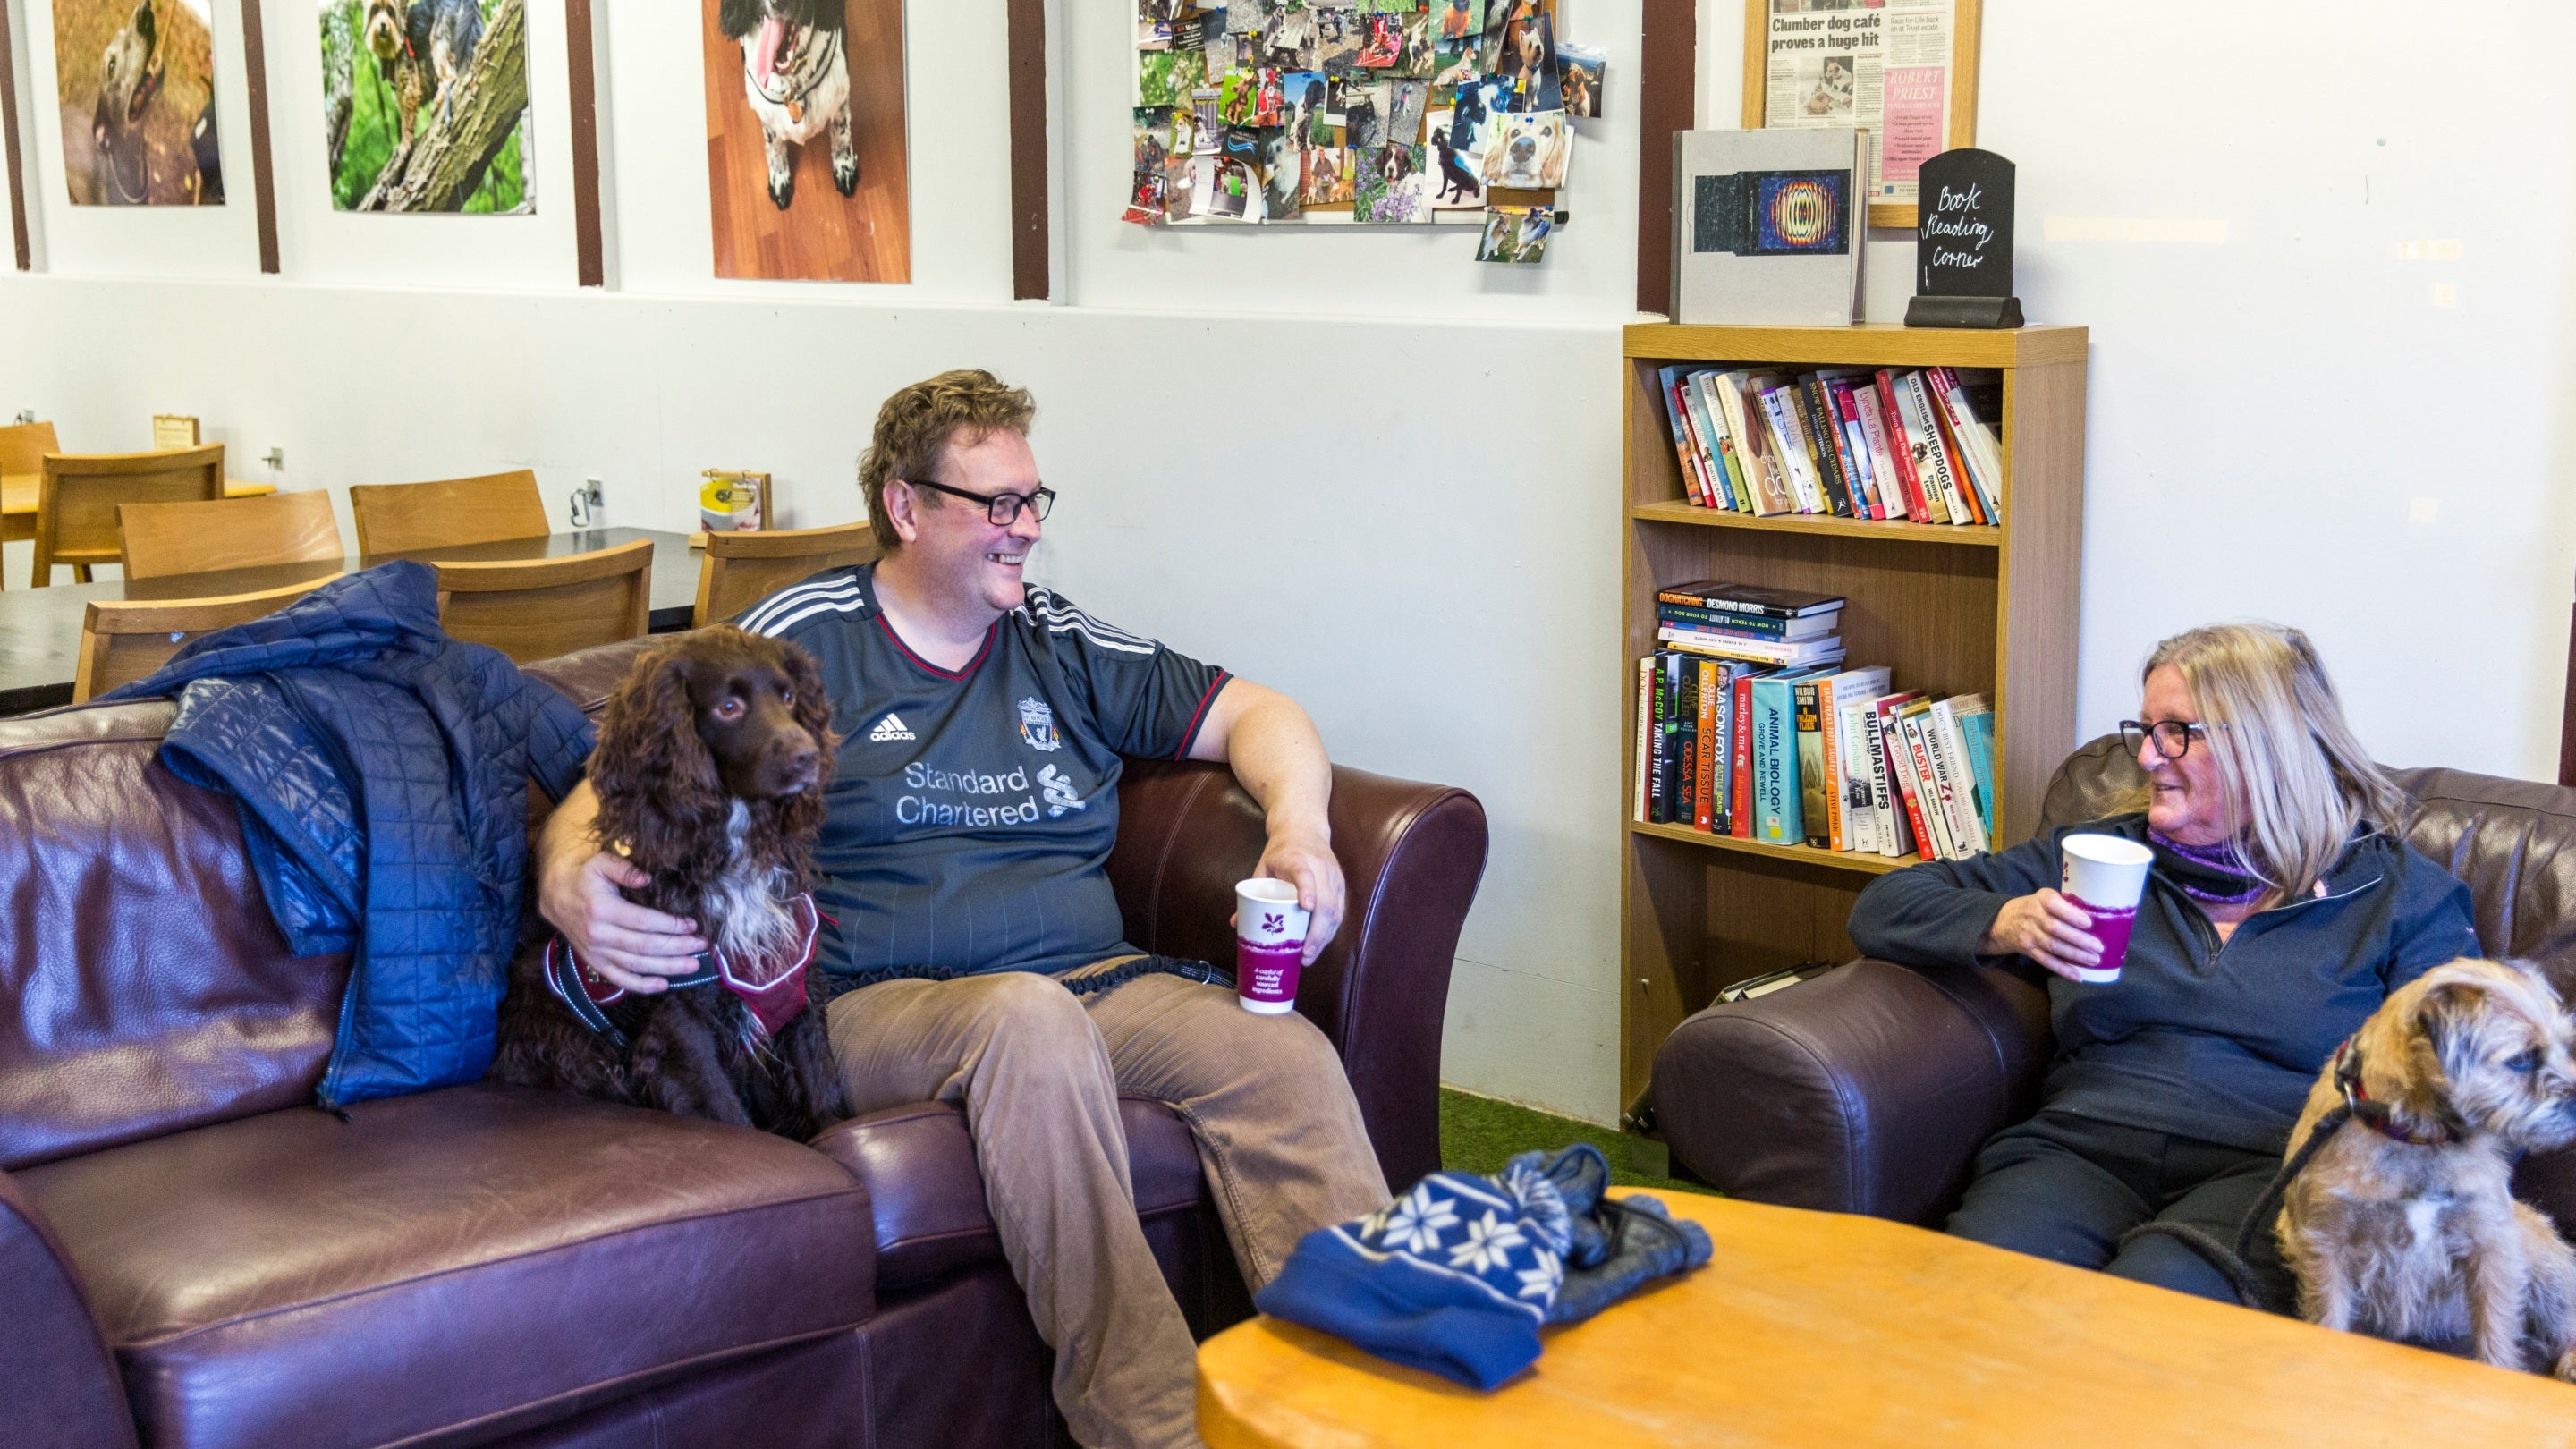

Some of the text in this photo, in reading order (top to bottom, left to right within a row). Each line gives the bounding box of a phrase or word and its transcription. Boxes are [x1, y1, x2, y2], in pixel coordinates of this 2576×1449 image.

[1772, 13, 1881, 33] Clumber dog café
[1771, 32, 1879, 53] proves a huge hit
[1890, 71, 1940, 84] ROBERT
[1893, 87, 1936, 100] PRIEST
[1938, 182, 1982, 212] Book
[1926, 213, 1994, 251] Reading
[1933, 246, 1983, 267] Corner
[1704, 377, 1716, 404] Friends
[1716, 417, 1724, 434] Life
[1784, 408, 1802, 446] ENDAL
[1809, 382, 1842, 485] SNOW FALLING ON CEDARS
[1811, 414, 1827, 458] DAVID GUTERSON
[1860, 392, 1885, 457] Lynda La Plante
[1911, 377, 1919, 393] OLD
[1916, 394, 1930, 424] ENGLISH
[1924, 424, 1953, 490] SHEEPDOGS
[1891, 410, 1916, 482] Train Your Dog Positively
[1707, 463, 1724, 504] DAVID GRANT
[1923, 479, 1935, 501] Lewis
[1928, 475, 1941, 502] Damien
[1659, 592, 1703, 607] DOGWATCHING
[1707, 598, 1764, 614] DESMOND MORRIS
[1709, 614, 1730, 624] RELATIVITY
[1640, 670, 1648, 697] DOG
[1682, 675, 1690, 716] CUSSLER
[1689, 684, 1699, 709] CLIVE
[1700, 670, 1709, 719] OLLERTON
[1794, 687, 1815, 696] WILBUR
[1824, 686, 1832, 704] EASY
[1796, 696, 1813, 705] SMITH
[1715, 687, 1726, 763] JASON FOX
[1796, 714, 1818, 722] FALCON
[1799, 722, 1815, 731] FLIES
[1826, 706, 1834, 727] PEASY
[870, 731, 916, 741] adidas
[1652, 668, 1665, 798] A.P. McCOY TAKING THE FALL
[1739, 735, 1746, 750] me
[1826, 728, 1835, 747] PUPPY
[1847, 711, 1863, 775] John Grisham
[1891, 736, 1899, 745] A
[1699, 728, 1711, 803] SCAR TISSUE
[1758, 723, 1767, 802] GROVE AND NEWELL
[1767, 708, 1783, 815] ANIMAL BIOLOGY
[1866, 710, 1889, 810] BULLMASTIFFS
[1894, 745, 1905, 768] Good
[1913, 743, 1930, 782] BUSTER
[1928, 729, 1952, 793] WORLD WAR Z
[1967, 720, 1987, 787] Fabulous Finn
[904, 761, 1029, 794] Standard
[1682, 741, 1692, 804] ODESSA SEA
[1736, 775, 1744, 789] john
[1900, 769, 1911, 788] Dog
[1936, 708, 1977, 843] DOG'S BEST FRIEND VALERIE O'FARRELL
[896, 795, 1039, 827] Chartered
[1931, 798, 1939, 817] BARROW
[1913, 812, 1926, 843] JON KATZ
[1952, 815, 1960, 832] BROOKS
[1252, 987, 1283, 995] ingredients
